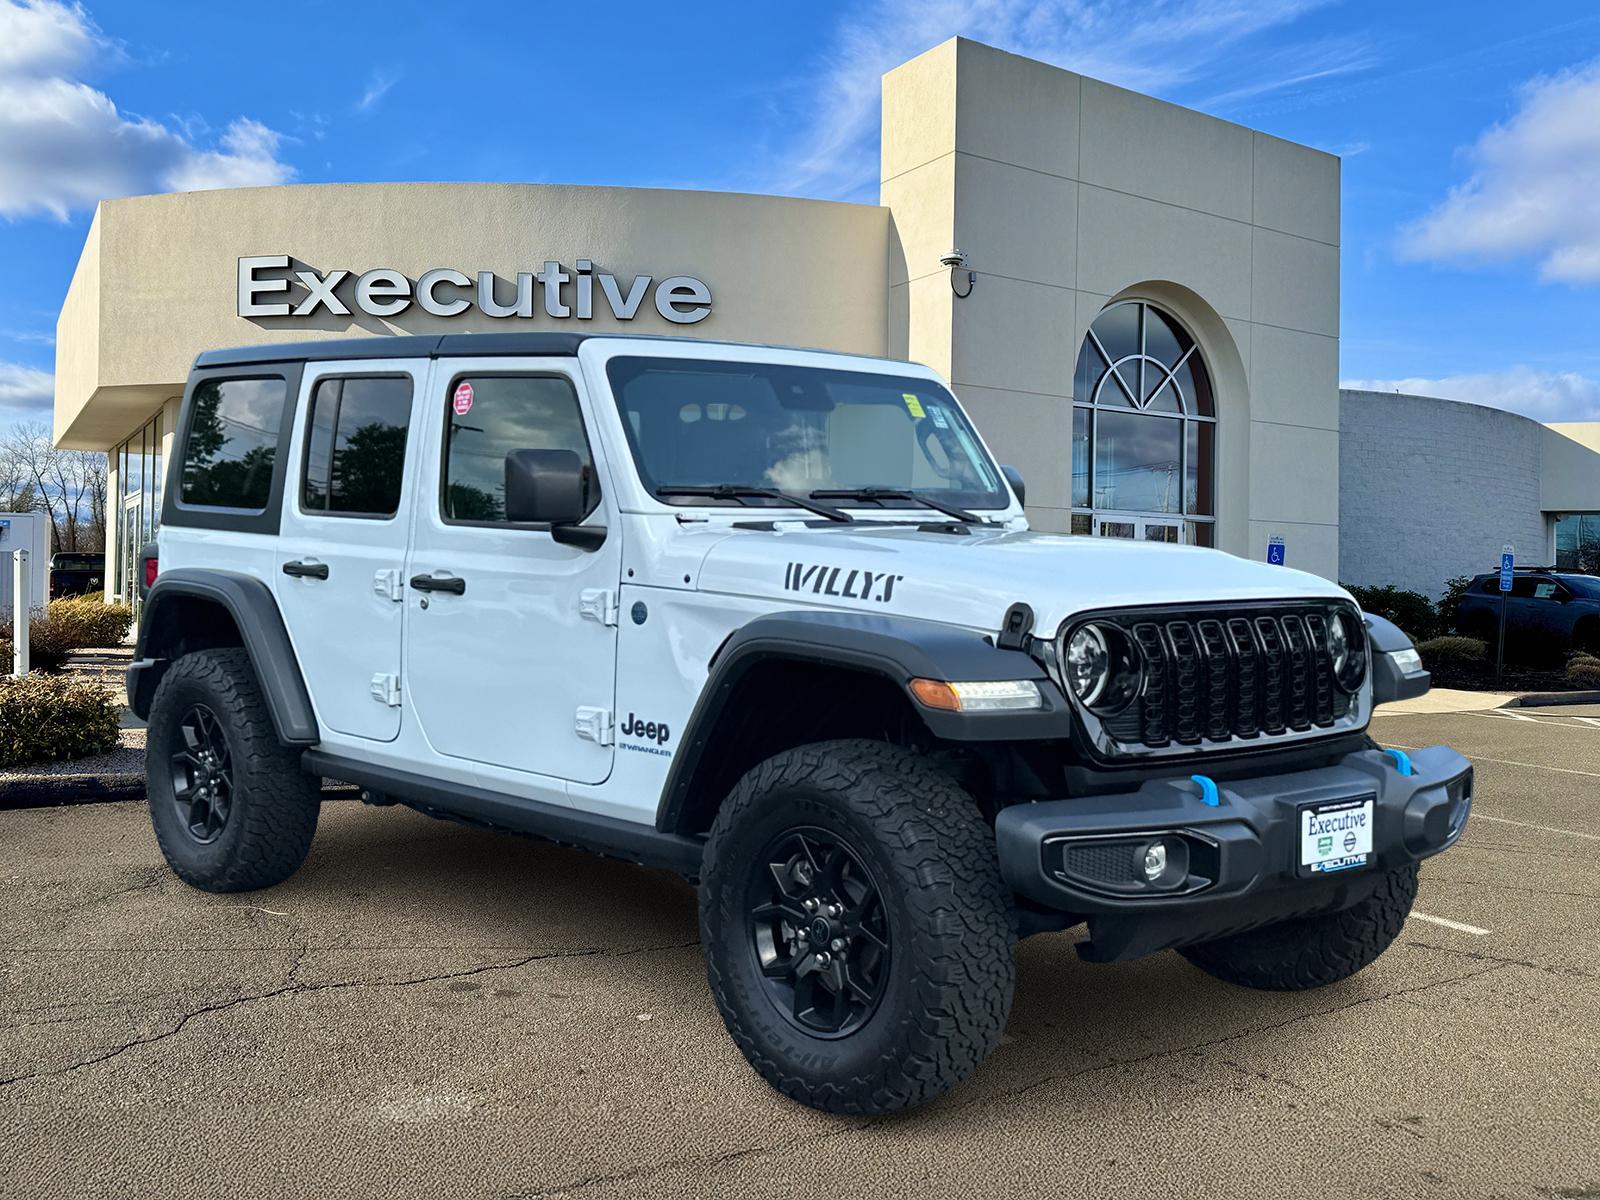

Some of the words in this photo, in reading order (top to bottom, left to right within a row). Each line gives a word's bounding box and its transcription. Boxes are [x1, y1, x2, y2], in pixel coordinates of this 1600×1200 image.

[237, 255, 713, 325] Executive
[784, 562, 904, 602] WILLYS
[621, 712, 670, 746] Jeep
[1308, 811, 1366, 836] Executive
